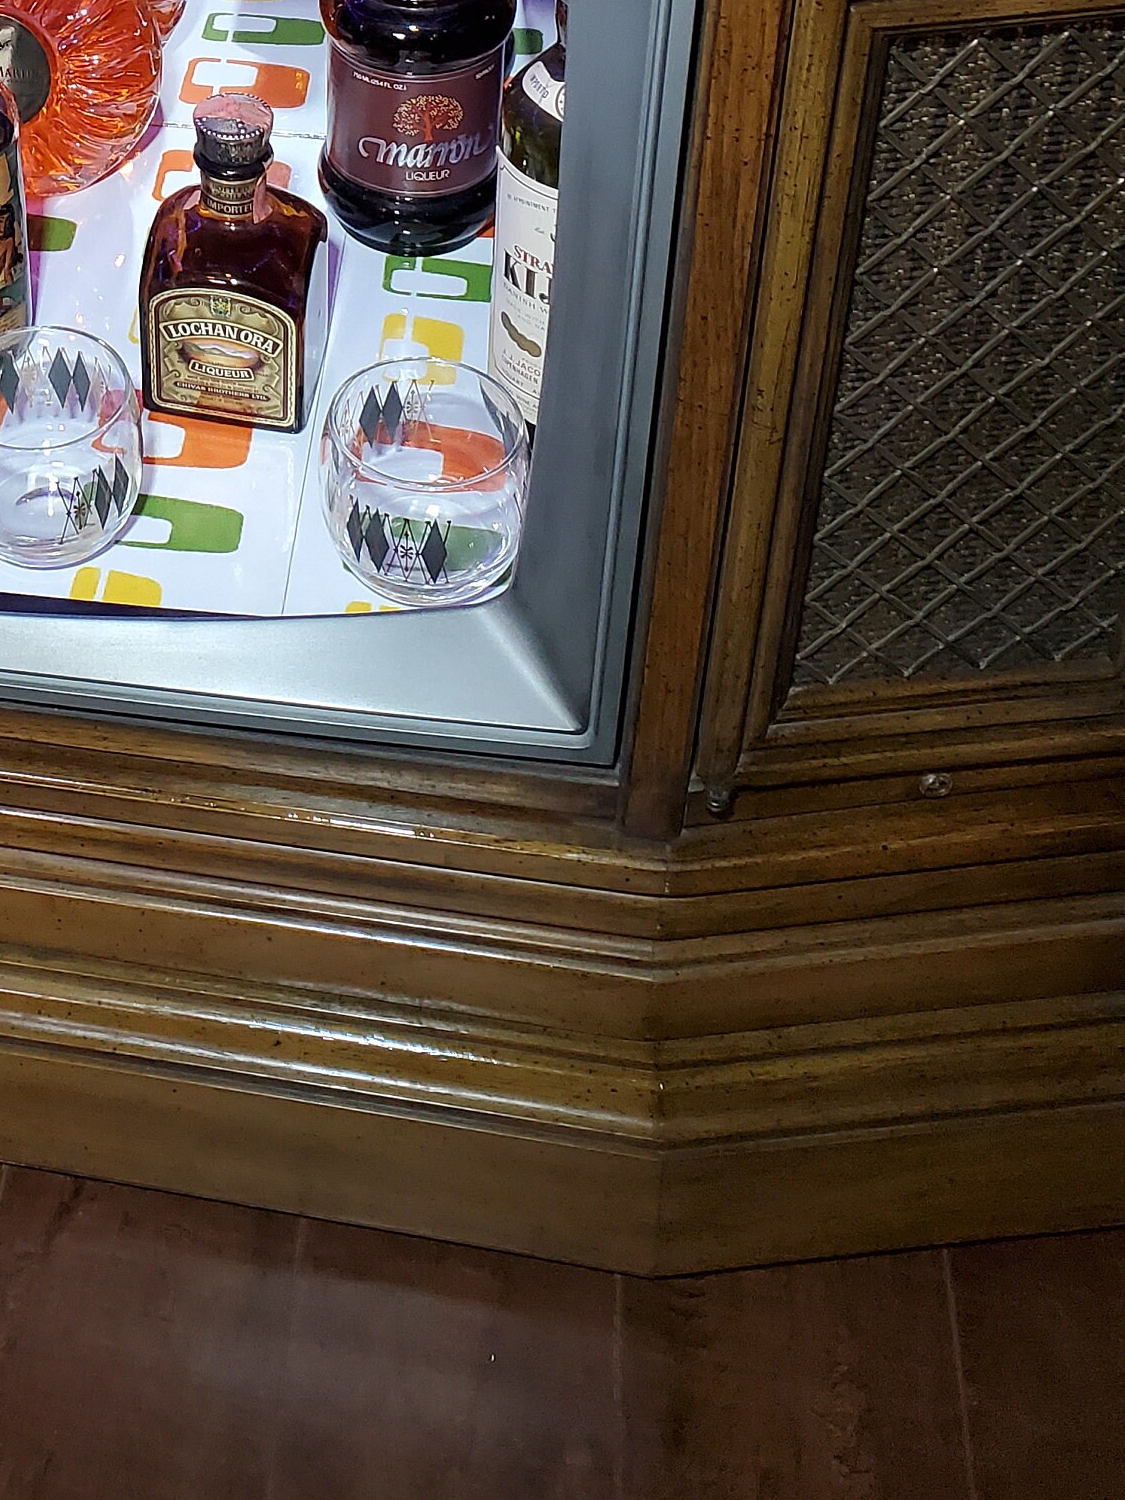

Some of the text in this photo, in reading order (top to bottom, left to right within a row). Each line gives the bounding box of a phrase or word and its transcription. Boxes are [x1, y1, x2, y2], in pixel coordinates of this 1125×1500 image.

[405, 169, 451, 182] LIQUEUR
[206, 198, 254, 215] IMPORTE
[169, 321, 274, 354] LOCHAN ORA
[194, 362, 251, 379] LIQUEUR
[176, 381, 206, 391] CHIVAS
[208, 386, 250, 398] BROTHERS
